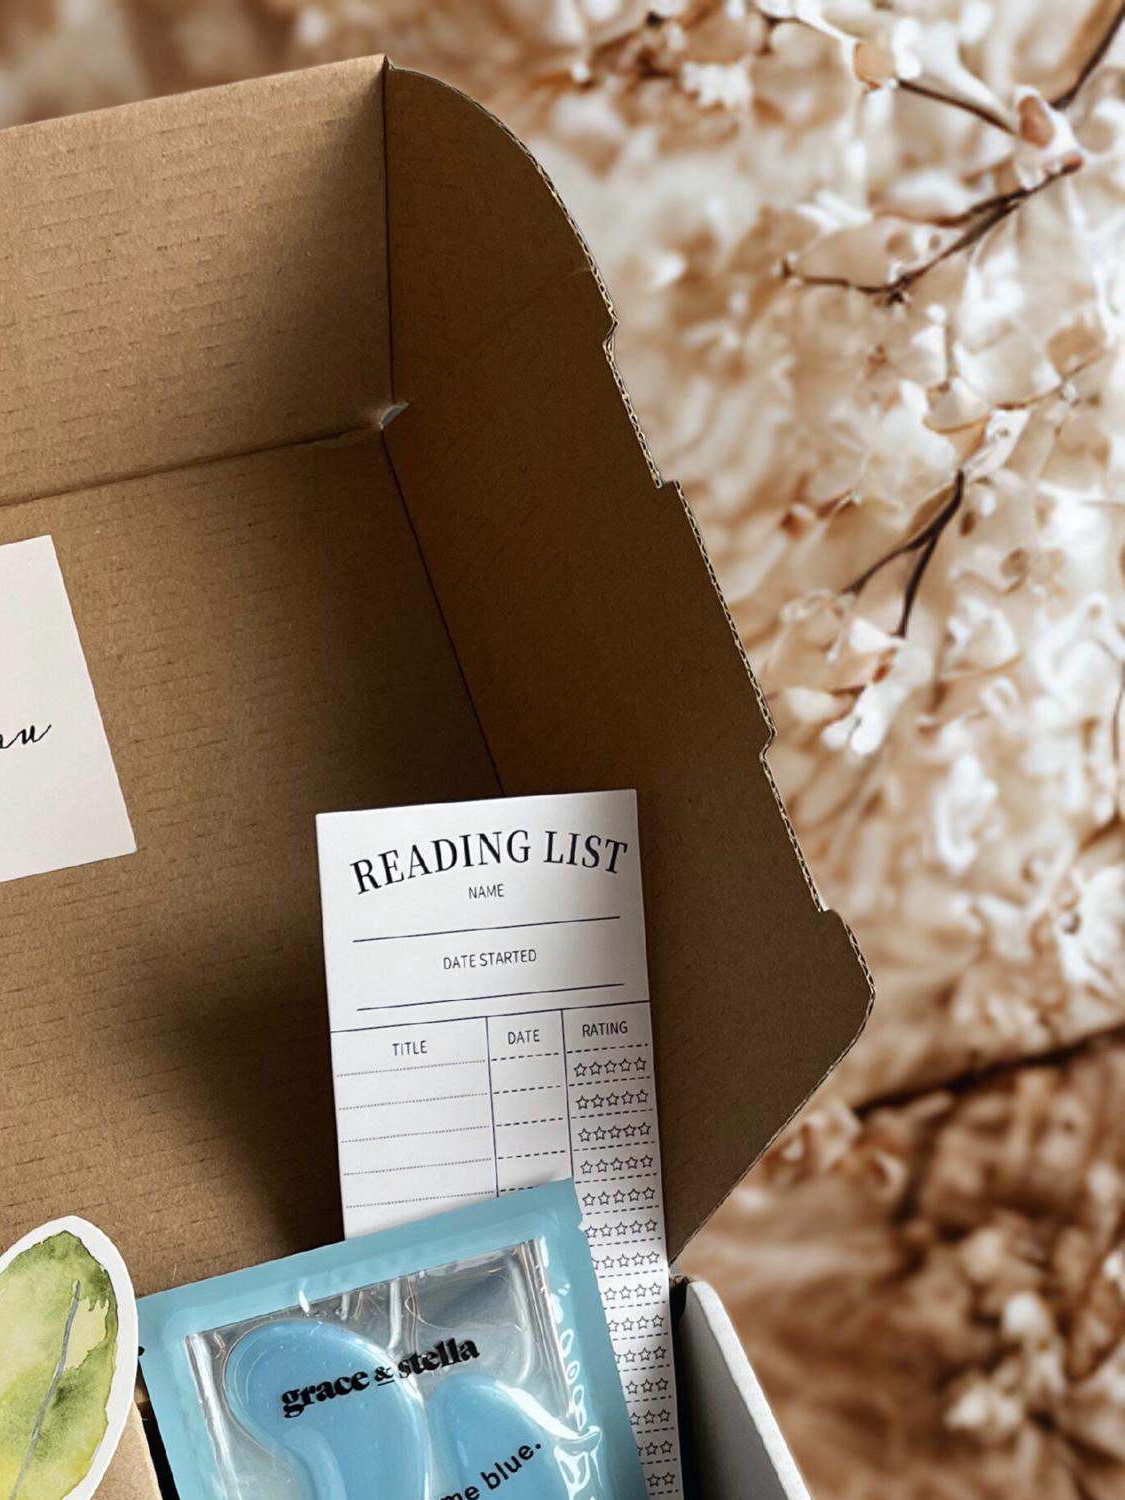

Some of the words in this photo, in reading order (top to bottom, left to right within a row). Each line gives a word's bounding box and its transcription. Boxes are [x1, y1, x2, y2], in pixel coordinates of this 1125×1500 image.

[349, 829, 532, 895] READING
[543, 829, 628, 874] LIST
[468, 884, 505, 900] NAME
[442, 953, 477, 970] DATE
[479, 949, 537, 967] STARTED
[507, 1029, 541, 1045] DATE
[582, 1021, 629, 1038] RATING
[391, 1040, 428, 1057] TITLE
[280, 1371, 370, 1419] grace
[374, 1365, 395, 1387] &
[397, 1336, 481, 1380] stella
[480, 1443, 542, 1490] blue.
